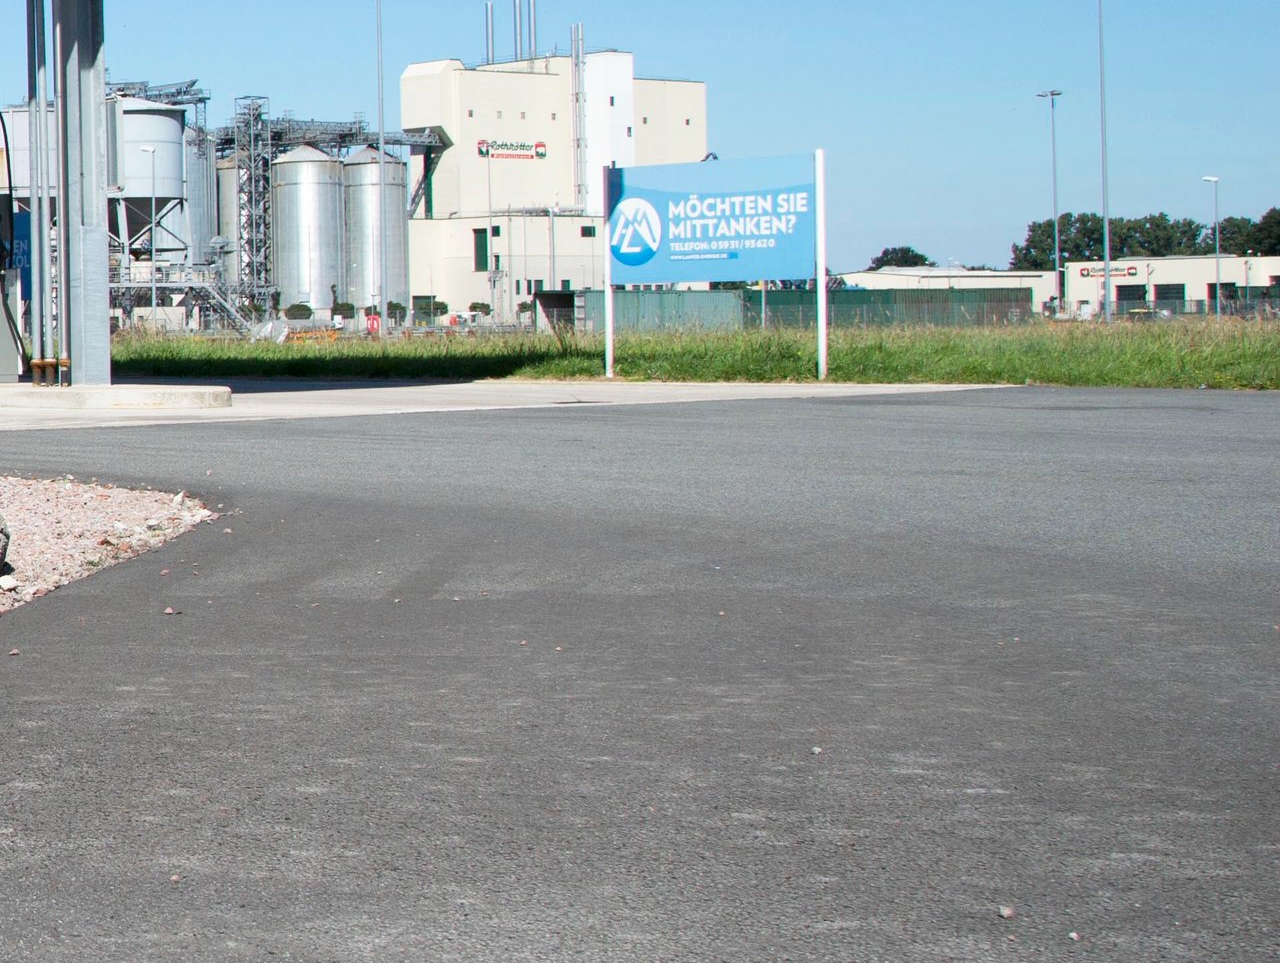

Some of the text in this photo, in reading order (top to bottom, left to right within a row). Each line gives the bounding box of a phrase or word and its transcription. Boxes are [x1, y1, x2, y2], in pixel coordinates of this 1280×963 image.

[668, 192, 808, 219] MÖCHTEN SIE
[668, 214, 797, 239] MITTANKEN?
[669, 241, 710, 252] TELEFON:
